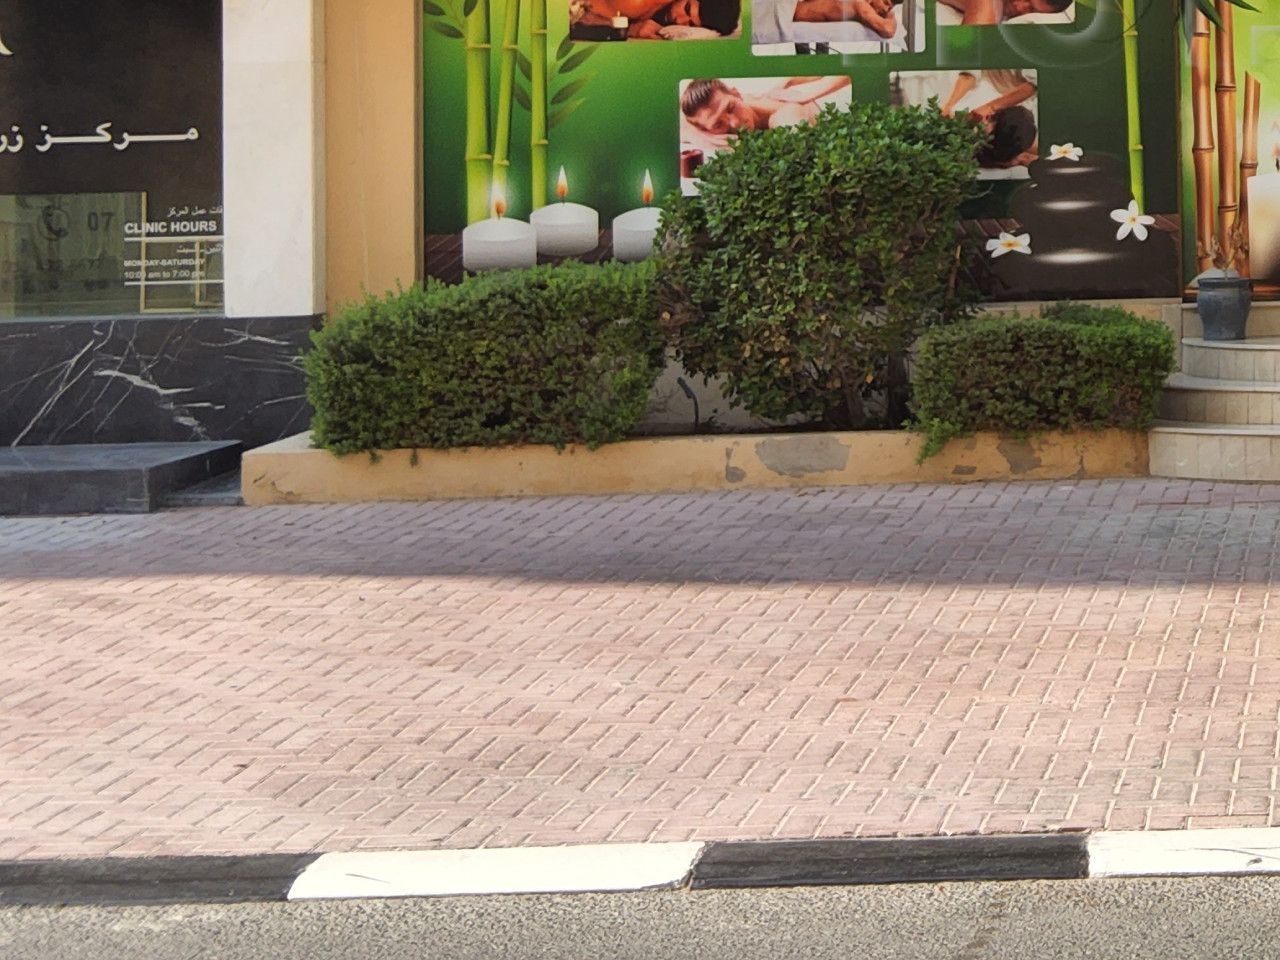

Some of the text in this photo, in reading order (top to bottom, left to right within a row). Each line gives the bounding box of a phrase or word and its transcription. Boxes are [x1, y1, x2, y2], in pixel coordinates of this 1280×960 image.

[35, 121, 199, 151] مركز
[124, 220, 217, 234] CLINIC HOURS
